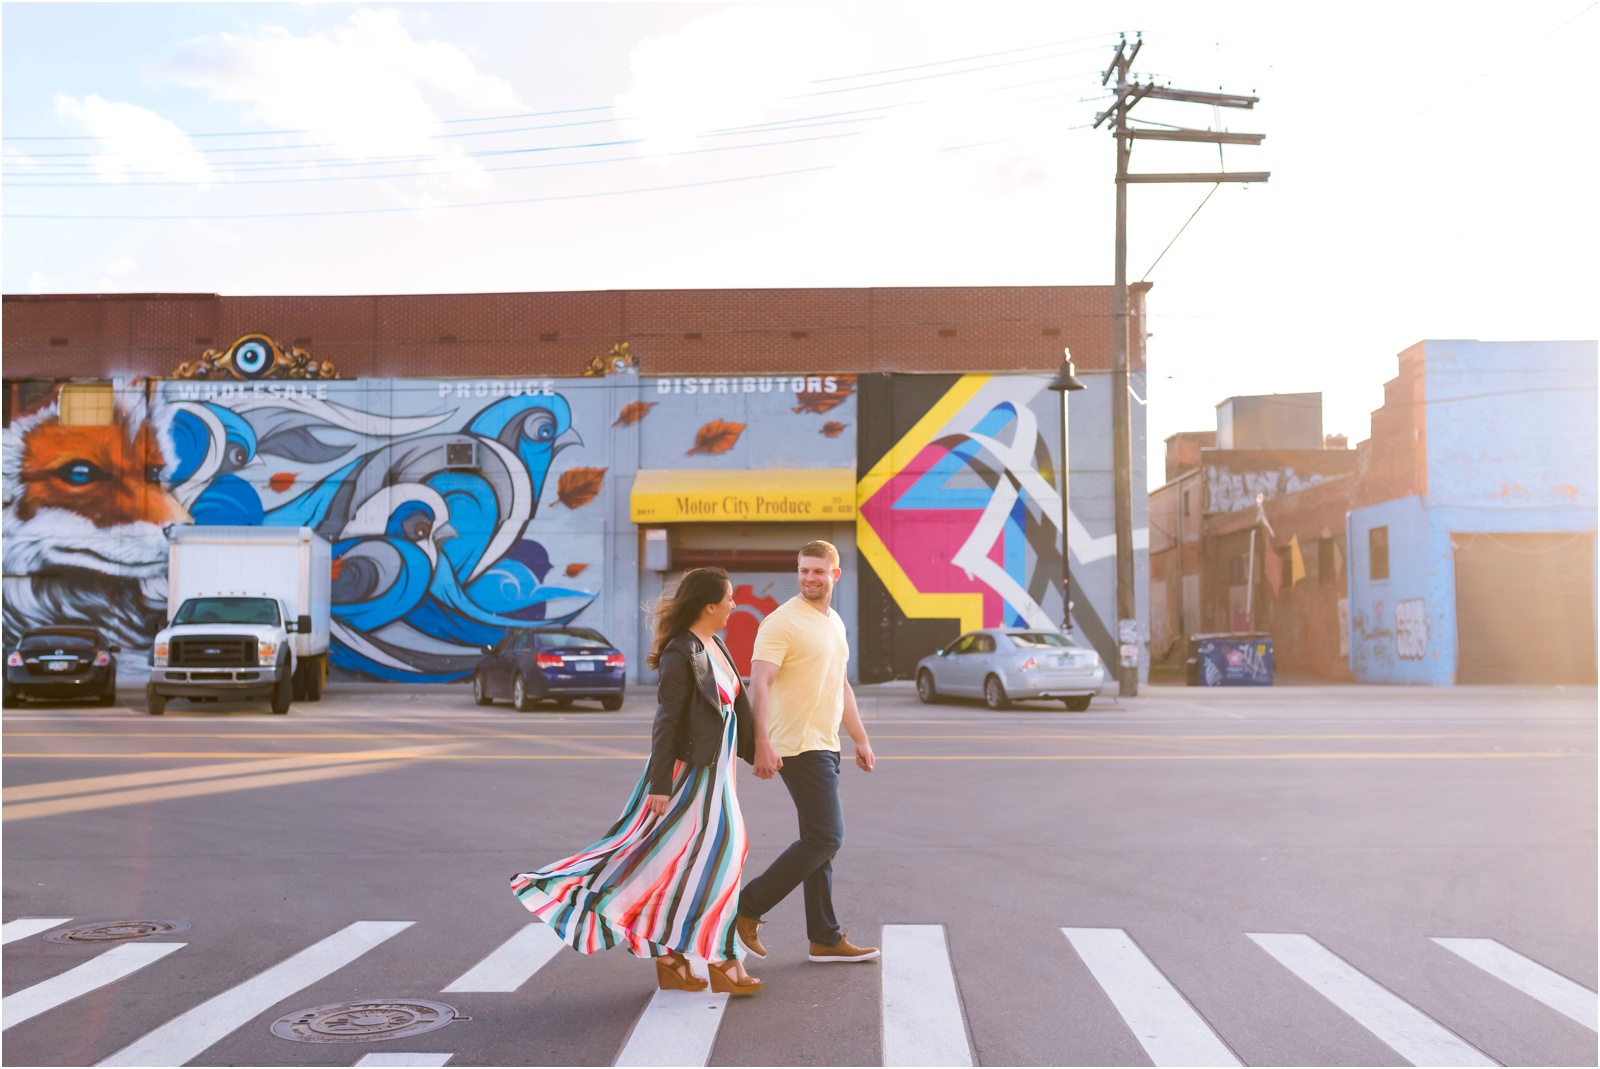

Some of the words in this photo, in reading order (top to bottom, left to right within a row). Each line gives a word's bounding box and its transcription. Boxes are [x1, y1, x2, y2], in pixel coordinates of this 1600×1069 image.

[178, 383, 328, 400] WHOLESALE
[438, 380, 556, 398] PRODUCE
[657, 376, 839, 395] DISTRIBUTORS
[676, 496, 719, 515] Motor
[722, 496, 752, 519] City
[756, 496, 812, 515] Produce
